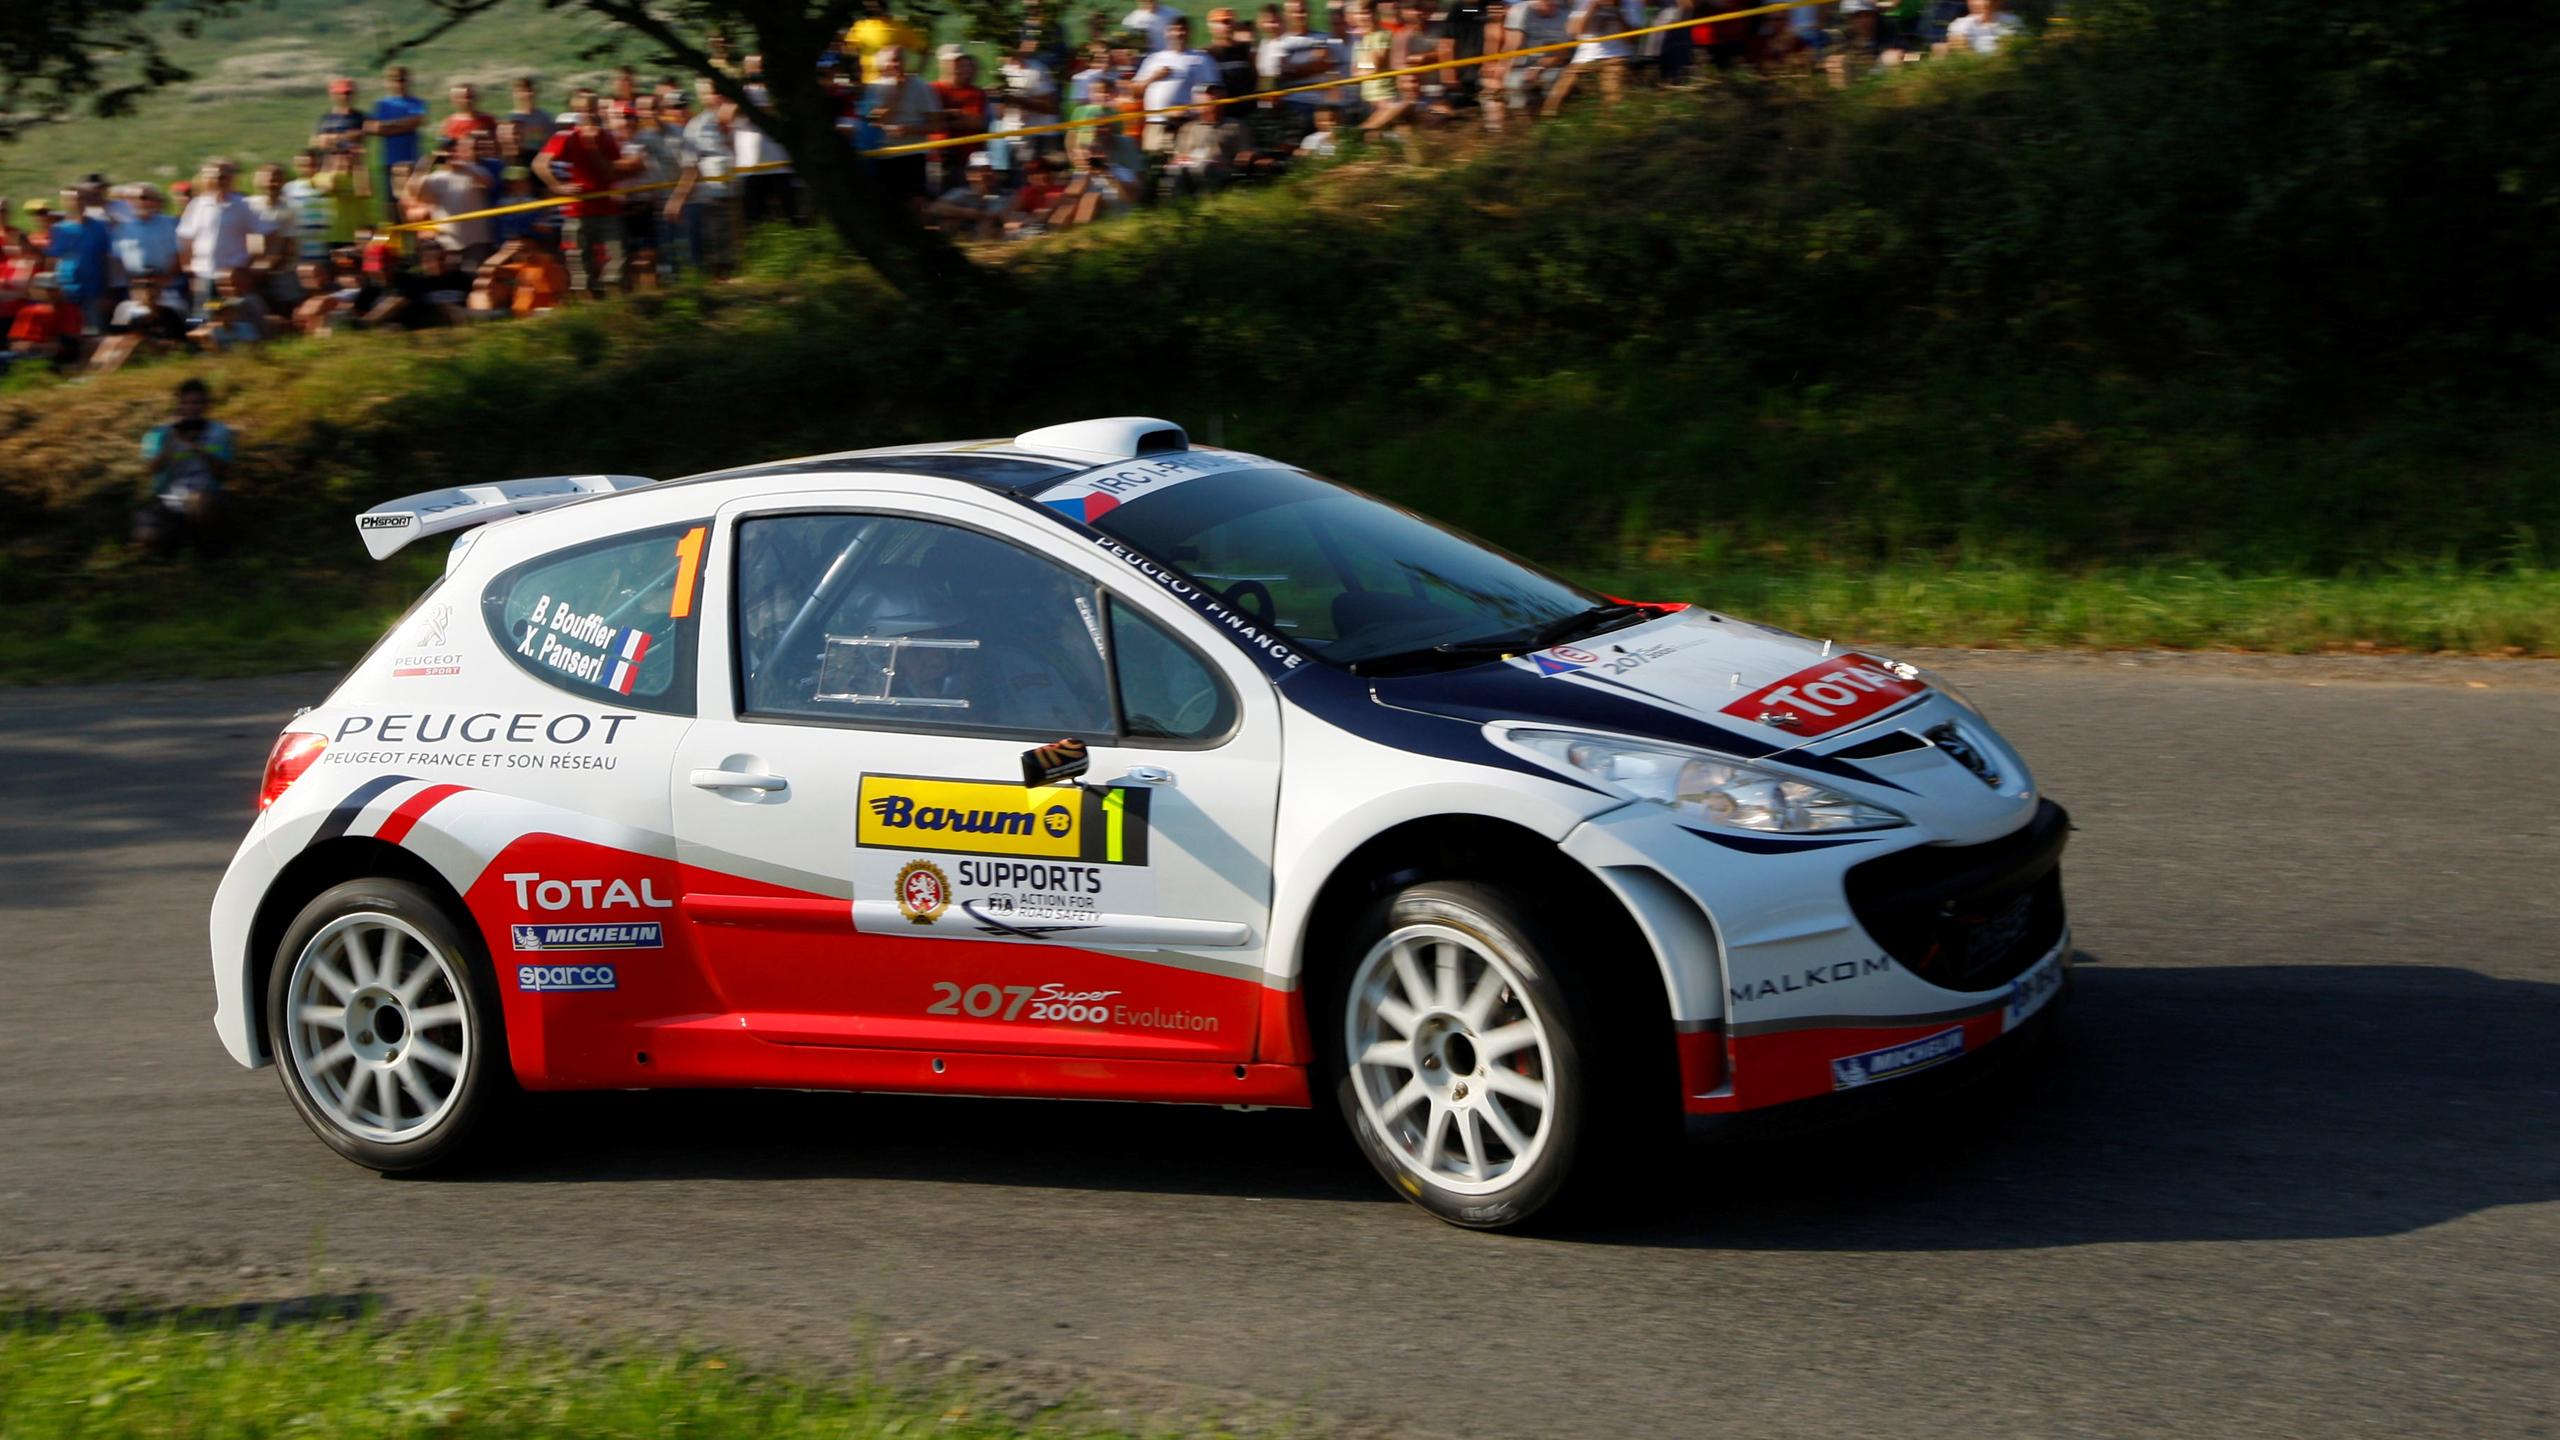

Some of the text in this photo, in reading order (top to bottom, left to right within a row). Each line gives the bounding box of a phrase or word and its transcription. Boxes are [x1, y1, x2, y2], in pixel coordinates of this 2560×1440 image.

[1088, 471, 1151, 495] IRC
[670, 527, 706, 618] 1
[531, 594, 617, 649] B. Bouffier
[1206, 603, 1303, 669] FINANCE
[395, 655, 463, 666] PEUGEOT
[517, 625, 606, 682] X. Panseri
[334, 713, 637, 744] PEUGEOT
[323, 751, 617, 770] PEUGEOT FRANCE ET SON RÉSEAU
[870, 795, 1034, 836] Barum
[1102, 788, 1125, 862] 1
[503, 872, 673, 910] TOTAL
[959, 860, 1101, 893] SUPPORTS
[1018, 906, 1053, 918] ROAD
[1020, 893, 1066, 907] ACTION
[1069, 896, 1095, 908] FOR
[545, 926, 657, 943] MICHELIN
[519, 963, 614, 991] sparco
[1729, 954, 1891, 1006] MALKOM
[927, 981, 1122, 1021] 207 Super
[1029, 1003, 1219, 1032] 2000 Evolution
